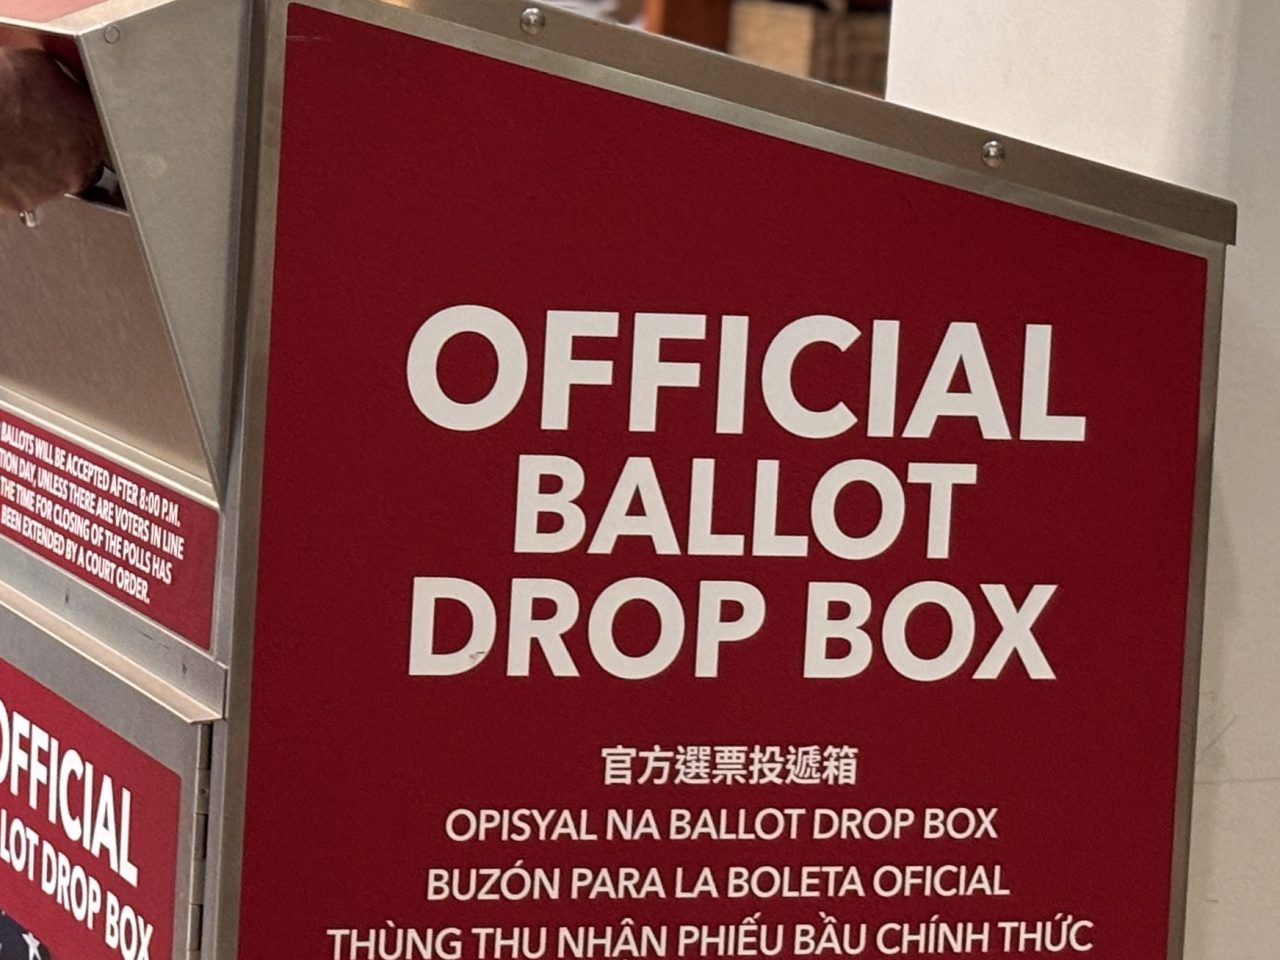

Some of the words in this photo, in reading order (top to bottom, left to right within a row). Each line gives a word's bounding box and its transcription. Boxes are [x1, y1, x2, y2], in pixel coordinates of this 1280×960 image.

[406, 304, 1087, 442] OFFICIAL
[1, 422, 34, 455] BALLOTS
[35, 437, 54, 464] WILL
[54, 446, 66, 470] BE
[66, 452, 109, 491] ACCEPTED
[109, 473, 139, 508] AFTER
[139, 487, 160, 518] 8:00
[161, 497, 181, 528] P.M.
[18, 456, 37, 487] DAY,
[37, 466, 68, 500] UNLESS
[68, 481, 97, 513] THERE
[96, 495, 114, 524] ARE
[114, 504, 149, 541] VOTERS
[150, 521, 161, 548] IN
[162, 528, 185, 561] LINE
[513, 454, 978, 561] BALLOT
[0, 476, 17, 501] THE
[15, 483, 36, 511] TIME
[36, 492, 53, 519] FOR
[54, 501, 89, 539] CLOSING
[90, 518, 104, 546] OF
[103, 525, 122, 558] THE
[122, 535, 151, 574] POLLS
[152, 552, 172, 585] HAS
[0, 504, 22, 533] BEEN
[22, 514, 65, 556] EXTENDED
[65, 537, 77, 562] BY
[77, 545, 85, 569] A
[85, 545, 116, 585] COURT
[116, 560, 150, 604] ORDER.
[408, 576, 766, 680] DROP
[803, 580, 1058, 682] BOX
[601, 744, 859, 786] 官方選票投遞箱
[445, 808, 598, 842] OPISYAL
[605, 808, 661, 841] NA
[669, 807, 807, 841] BALLOT
[812, 807, 915, 840] DROP
[923, 807, 998, 840] BOX
[41, 839, 102, 930] DROP
[104, 890, 154, 960] BOX
[427, 859, 561, 901] BUZÓN
[570, 867, 667, 900] PARA
[674, 866, 719, 899] LA
[727, 865, 866, 899] BOLETA
[872, 864, 1011, 898] OFICIAL
[326, 919, 462, 960] THÙNG
[471, 926, 547, 960] THU
[677, 911, 784, 957] PHIẾU
[793, 911, 867, 956] BẦU
[876, 914, 990, 955] CHÍNH
[997, 912, 1094, 953] THỨC
